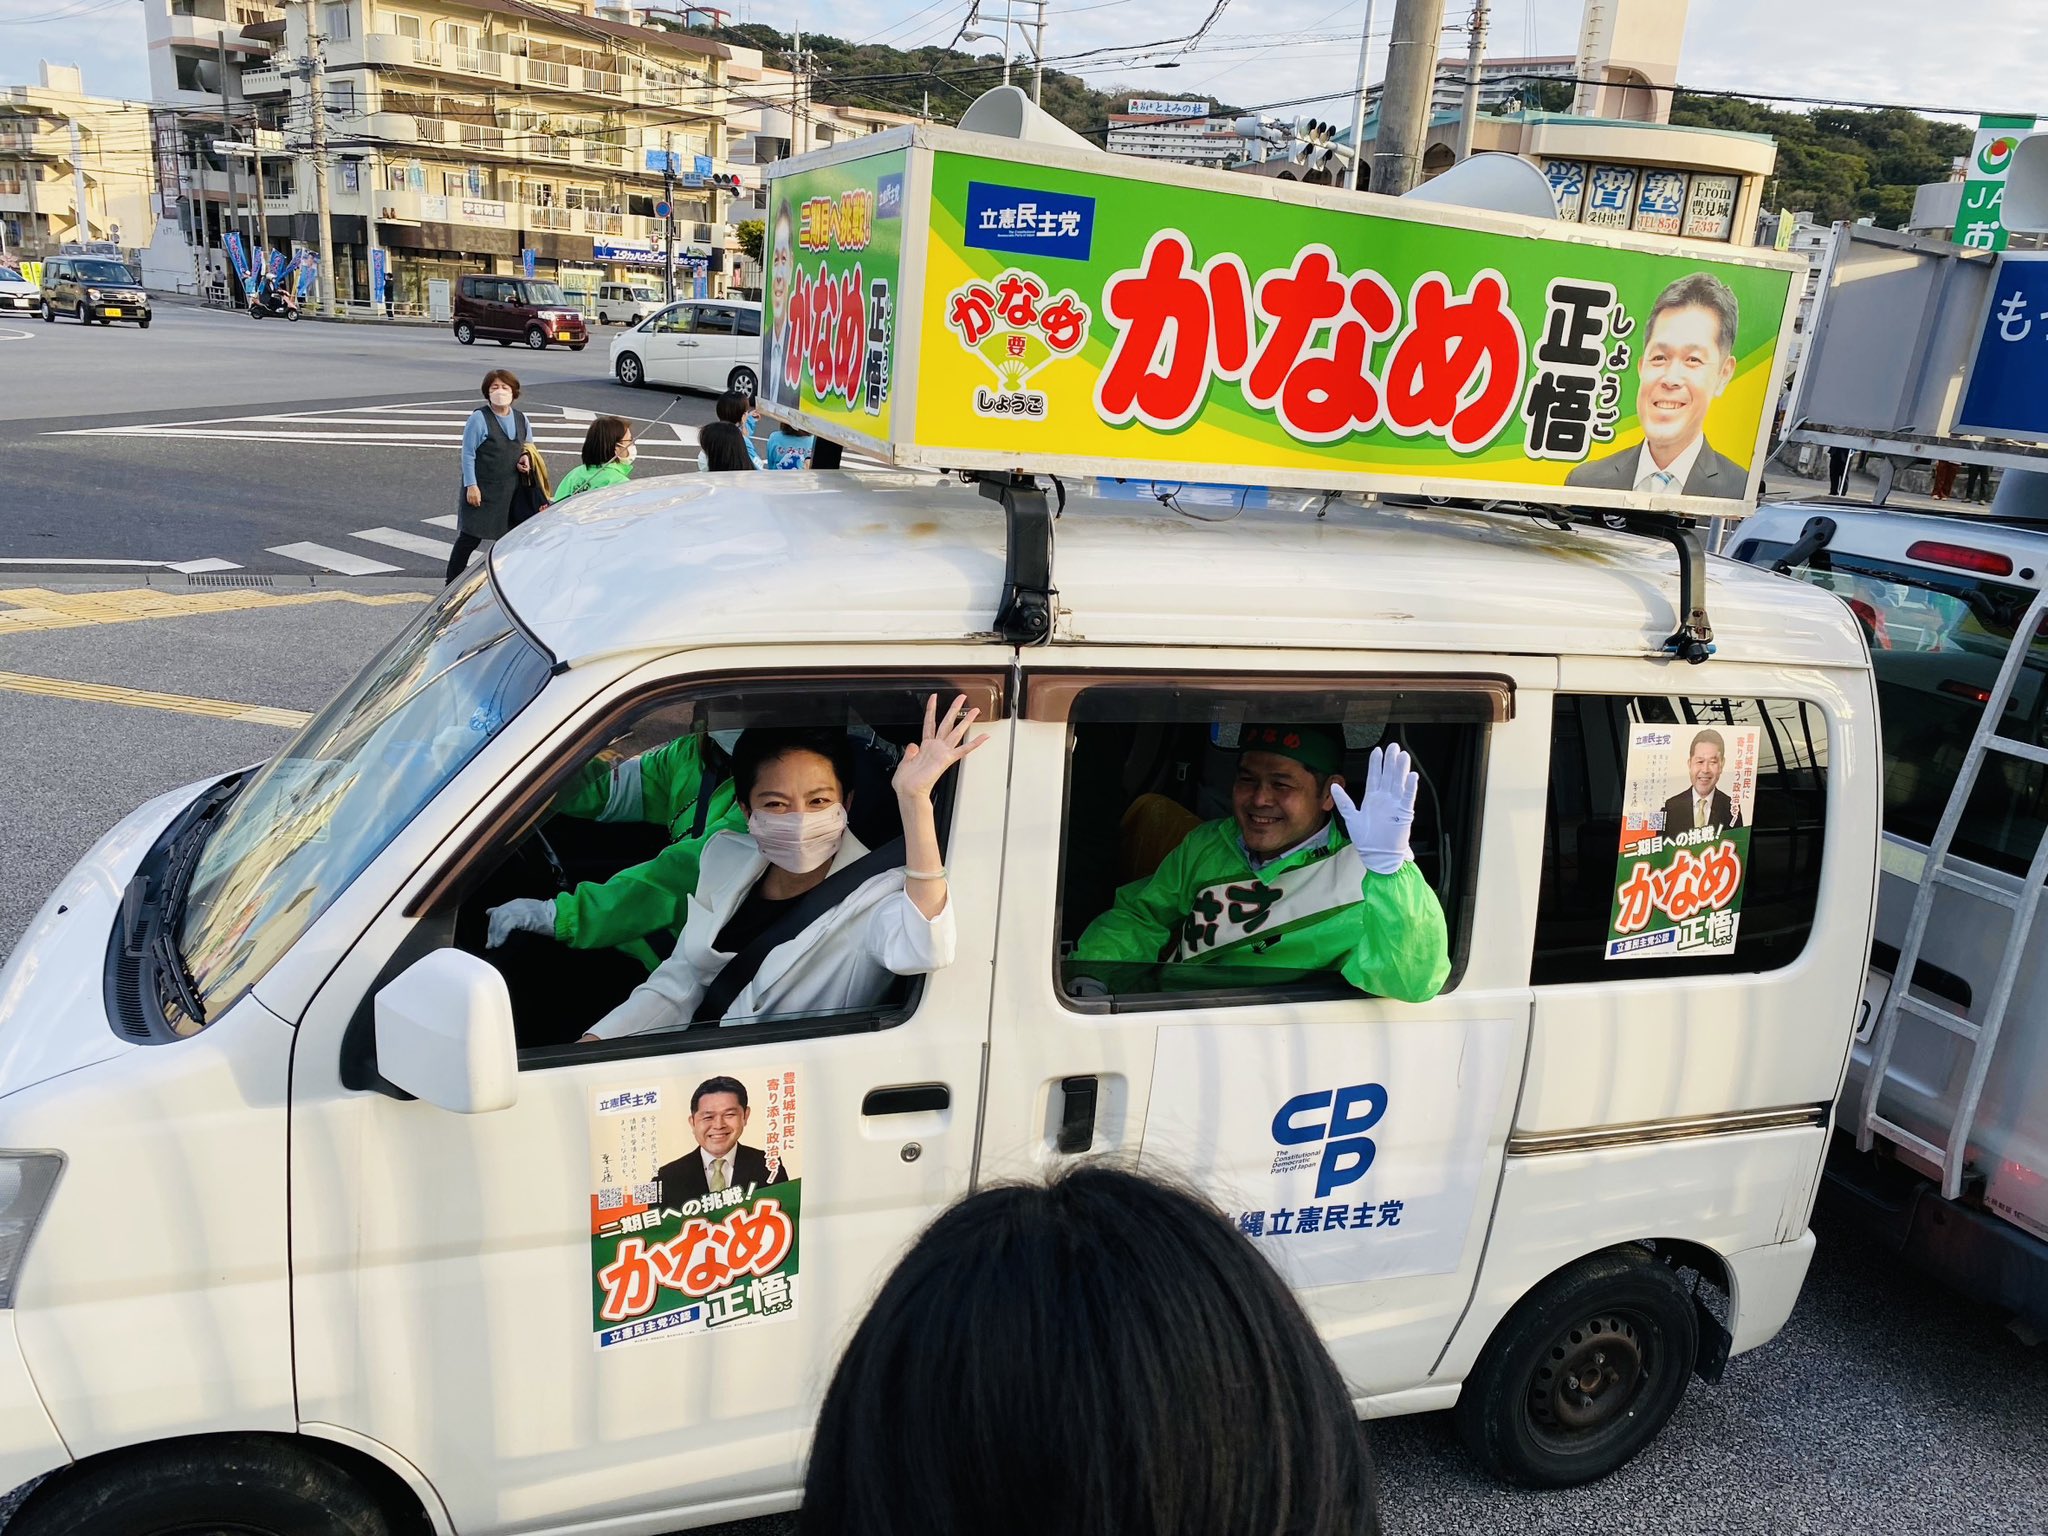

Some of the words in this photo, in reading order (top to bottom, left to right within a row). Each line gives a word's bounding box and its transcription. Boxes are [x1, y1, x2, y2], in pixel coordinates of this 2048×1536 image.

[1546, 161, 1684, 215] 学習塾
[1692, 199, 1730, 218] 豊見城
[1695, 182, 1731, 200] From
[979, 203, 1081, 237] 立憲民主党
[1638, 216, 1655, 228] TEL
[1657, 217, 1679, 230] 856
[785, 262, 865, 406] かなめ
[952, 276, 1085, 350] かなめ
[1997, 291, 2048, 342] も
[1007, 335, 1027, 358] 要
[1098, 233, 1524, 449] かなめ
[1530, 283, 1611, 455] 正悟
[1591, 304, 1634, 438] しょうご
[978, 390, 1044, 416] しょうご
[1624, 824, 1724, 858] 二期目への挑戦!
[1617, 843, 1739, 931] かなめ
[1677, 909, 1733, 949] 正悟
[599, 1091, 657, 1111] 立憲民主党
[783, 1071, 796, 1150] 豊見城市民に
[766, 1078, 781, 1184] 寄り添う政治を!
[1273, 1149, 1321, 1163] Constitutional
[1272, 1157, 1311, 1168] Democratic
[600, 1183, 756, 1239] 二期目への挑戦!
[602, 1202, 789, 1317] かなめ
[706, 1271, 789, 1326] 正悟
[609, 1309, 692, 1343] 立憲民主党公認
